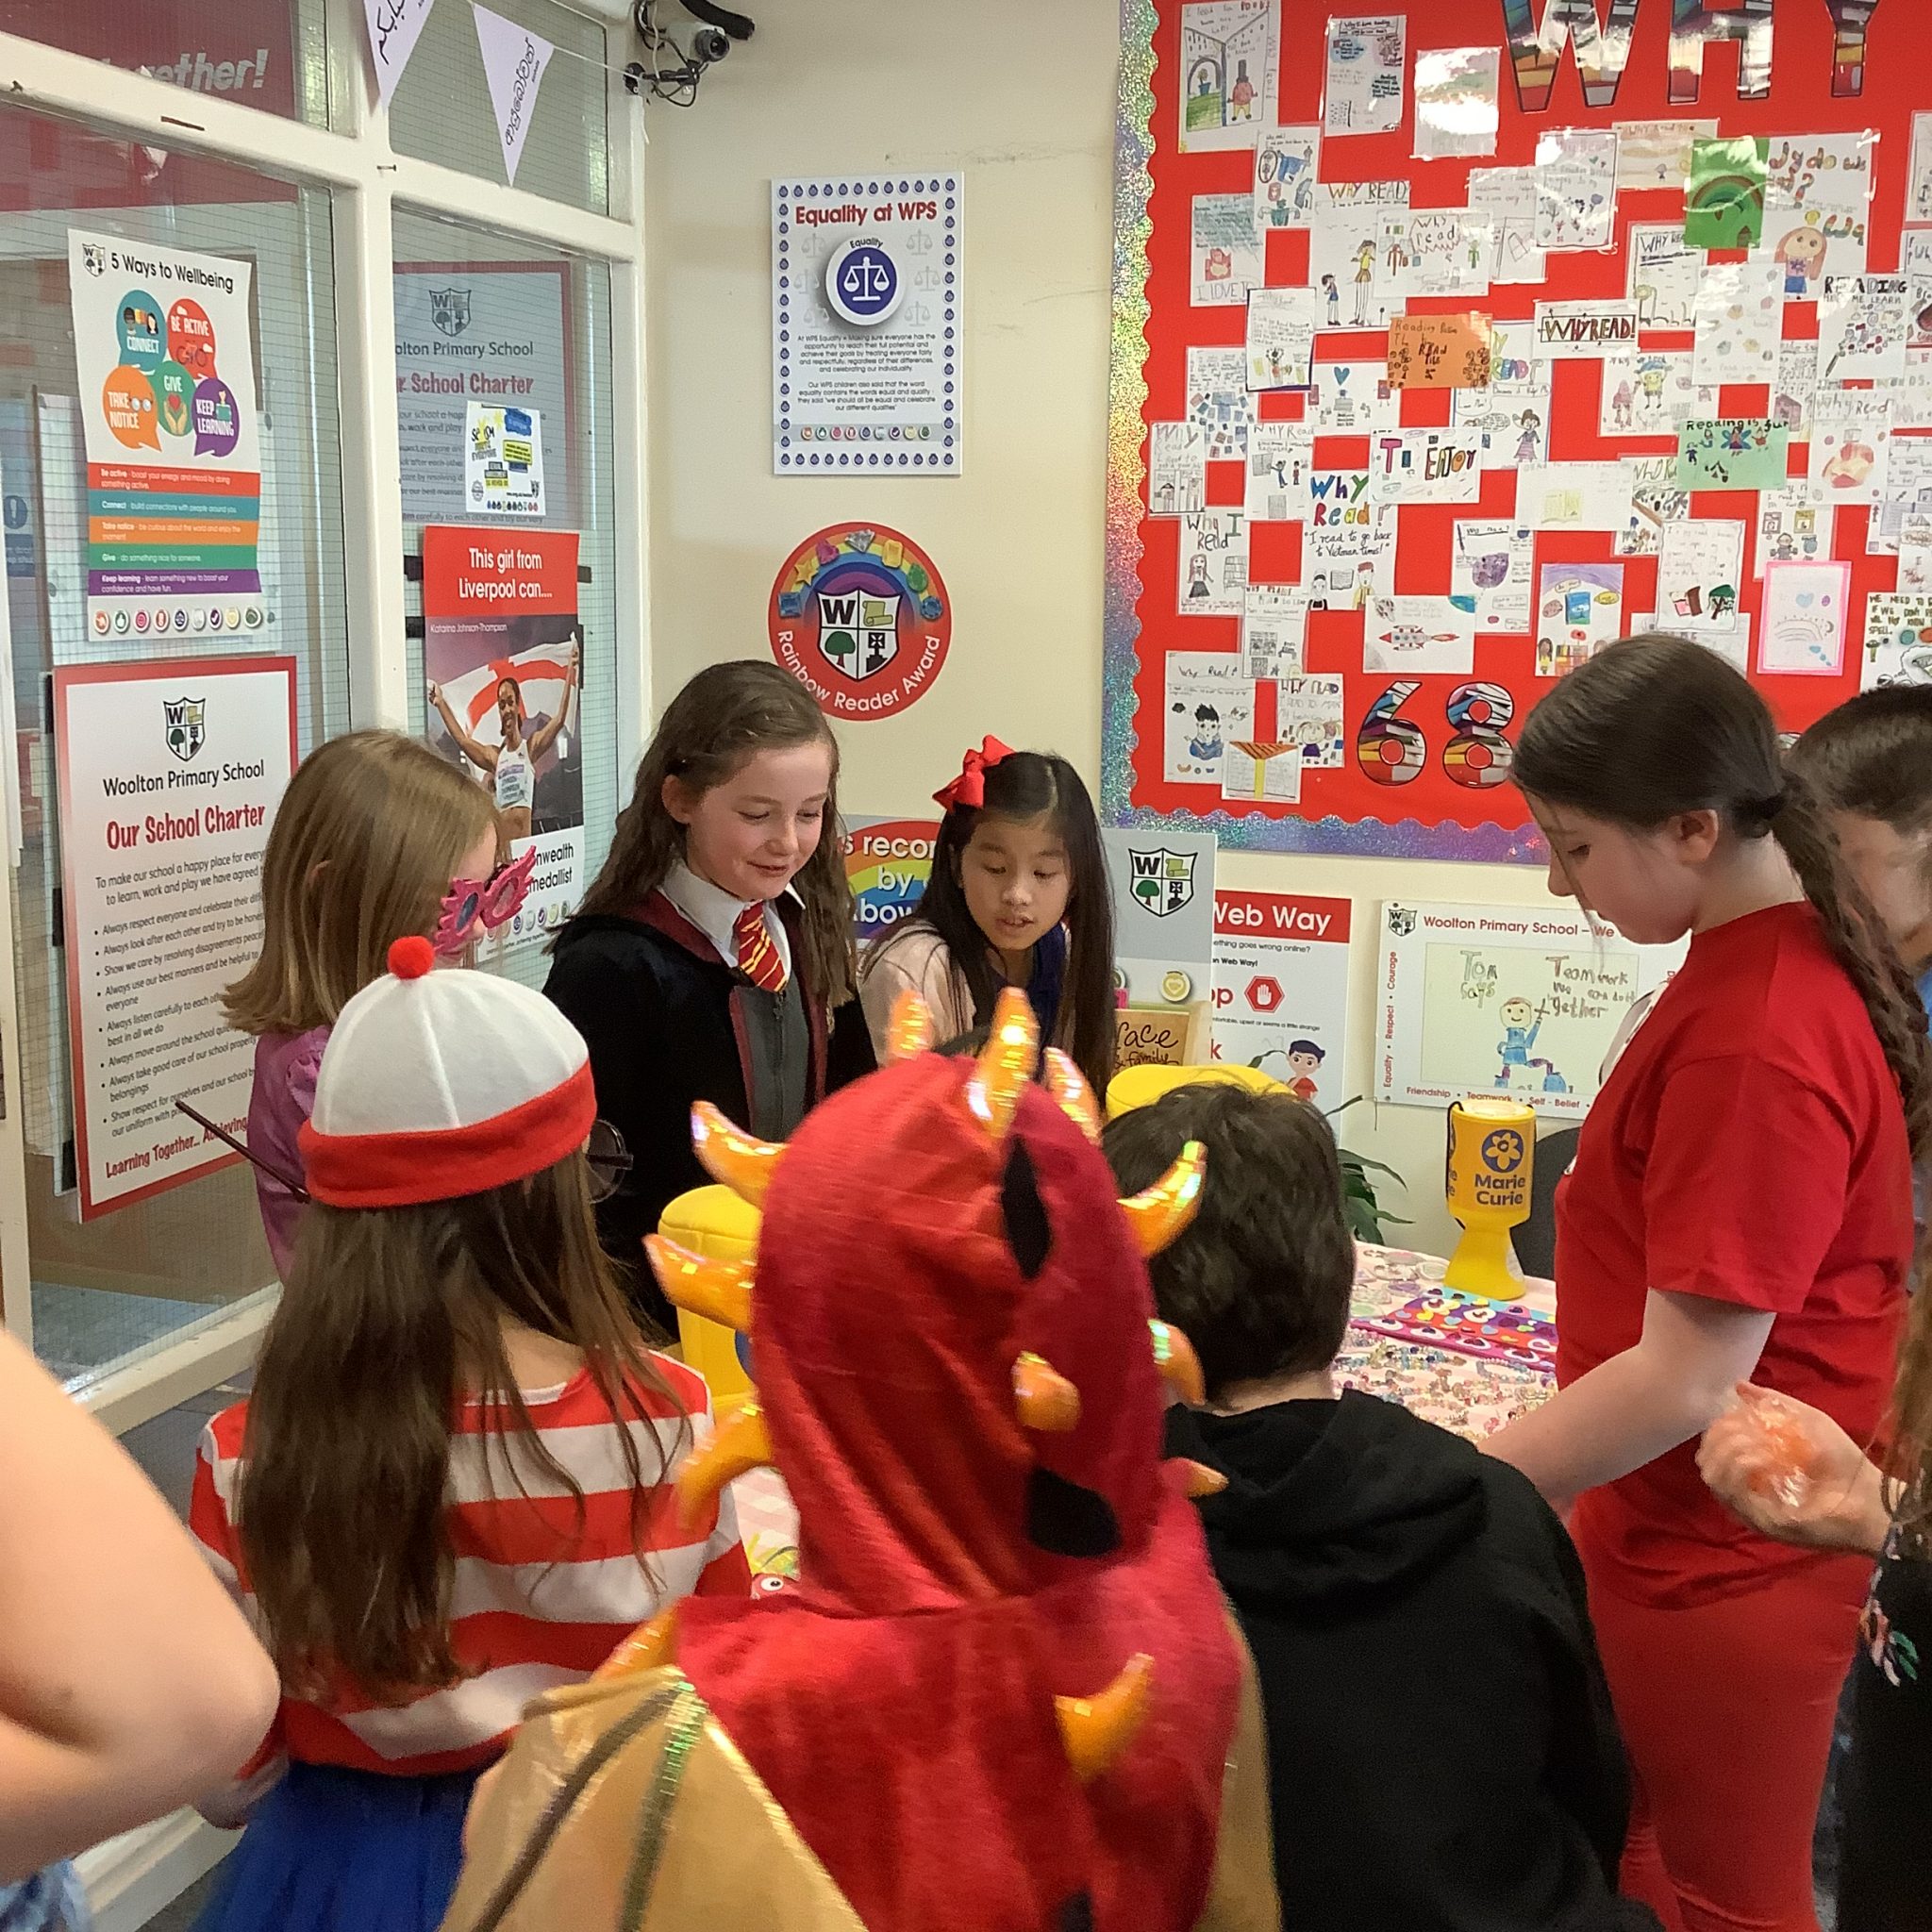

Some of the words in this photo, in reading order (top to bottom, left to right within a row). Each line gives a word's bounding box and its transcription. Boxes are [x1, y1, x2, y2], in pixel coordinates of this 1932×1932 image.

[106, 49, 269, 92] ether!
[795, 205, 868, 227] Equality
[874, 203, 892, 222] at
[898, 201, 938, 220] WPS
[849, 238, 884, 249] Equality
[111, 253, 120, 269] 5
[123, 255, 157, 278] Ways
[159, 266, 173, 278] to
[175, 264, 234, 293] Wellbeing
[171, 316, 181, 333] BE
[184, 318, 208, 336] ACTIVE
[126, 336, 159, 354] CONNECT
[394, 341, 429, 356] olton
[433, 341, 485, 359] Primary
[489, 341, 534, 357] School
[164, 375, 183, 392] GIVE
[411, 372, 464, 394] School
[470, 373, 534, 395] Charter
[108, 391, 129, 408] TAKE
[196, 399, 214, 414] KEEP
[109, 411, 140, 429] NOTICE
[197, 418, 234, 436] LEARNING
[469, 548, 493, 569] This
[497, 549, 514, 574] girl
[517, 550, 542, 570] from
[458, 577, 516, 602] Liverpool
[822, 599, 856, 625] W
[777, 630, 831, 700] Rainbow
[834, 689, 900, 711] Reader
[902, 635, 941, 694] Award
[167, 707, 184, 724] W
[103, 774, 163, 796] Woolton
[168, 769, 219, 789] Primary
[223, 759, 264, 781] School
[107, 821, 140, 849] Our
[145, 808, 200, 843] School
[205, 805, 265, 833] Charter
[536, 843, 574, 865] nwealth
[95, 876, 107, 889] To
[108, 873, 131, 888] make
[133, 870, 147, 882] our
[149, 862, 175, 879] school
[176, 865, 183, 874] a
[184, 858, 209, 875] happy
[210, 856, 231, 872] place
[232, 852, 243, 864] for
[1135, 857, 1160, 875] W
[106, 894, 116, 906] to
[117, 889, 141, 904] learn,
[142, 884, 163, 898] work
[163, 880, 180, 893] and
[181, 877, 199, 893] play
[200, 878, 211, 887] we
[212, 872, 231, 885] have
[232, 867, 258, 884] agreed
[878, 866, 914, 897] by
[103, 922, 128, 936] Always
[129, 916, 156, 930] respect
[156, 908, 188, 925] everyone
[188, 905, 202, 917] and
[203, 899, 232, 914] celebrate
[233, 894, 249, 907] their
[1272, 906, 1332, 936] Way
[1424, 916, 1475, 929] Woolton
[1479, 920, 1528, 934] Primary
[1532, 923, 1577, 935] School
[1594, 925, 1614, 937] We
[1258, 943, 1282, 952] wrong
[1284, 944, 1311, 953] online?
[1221, 957, 1238, 965] Web
[1240, 959, 1258, 968] Way!
[1388, 951, 1397, 991] Courage
[1385, 1005, 1394, 1040] Respect
[1383, 1055, 1393, 1088] Equality
[109, 1083, 149, 1102] belongings
[1407, 1087, 1451, 1098] Friendship
[1467, 1091, 1512, 1102] Teamwork
[1528, 1096, 1545, 1105] Self
[1555, 1098, 1580, 1108] Belief
[105, 1152, 151, 1178] Learning
[1474, 1173, 1525, 1191] Marie
[1476, 1191, 1524, 1207] Curie
